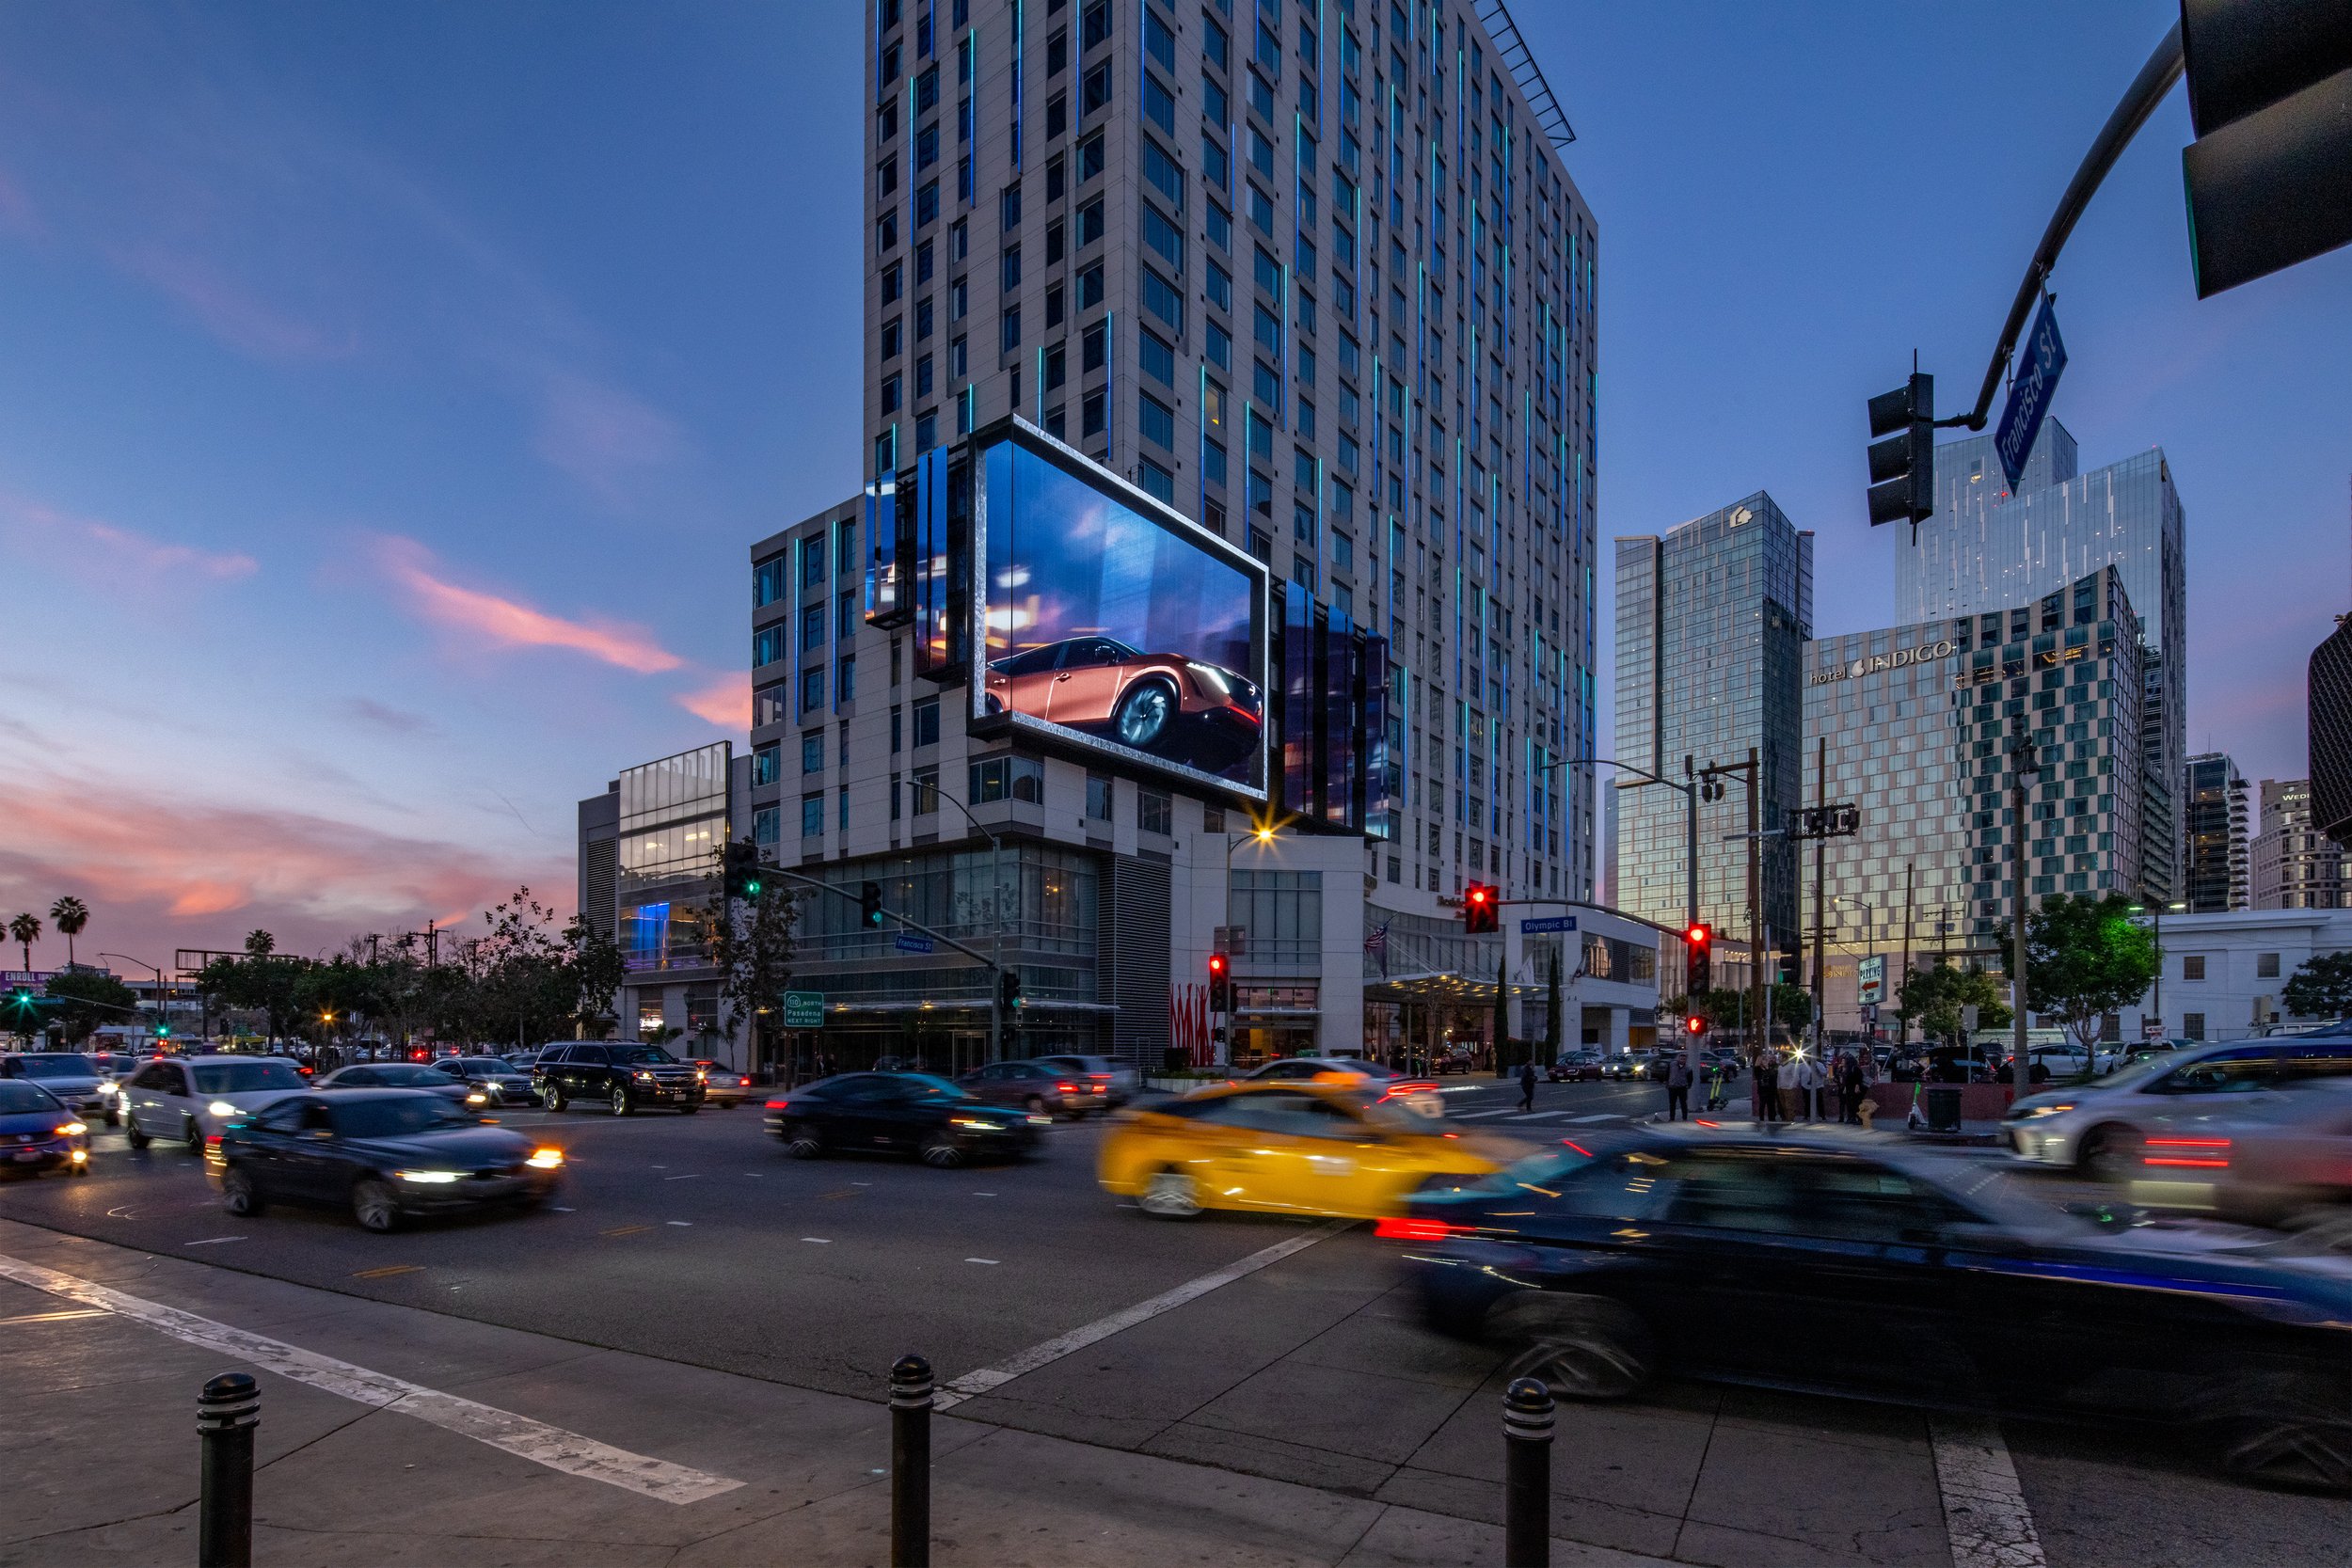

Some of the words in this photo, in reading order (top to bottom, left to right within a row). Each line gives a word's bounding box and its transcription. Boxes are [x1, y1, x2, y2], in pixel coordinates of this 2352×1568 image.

[2001, 363, 2043, 470] Francisco
[2039, 321, 2057, 370] St
[1810, 665, 1848, 685] hotel
[1869, 641, 1952, 673] INDIGO
[1525, 922, 1561, 931] Olympic
[1563, 919, 1573, 927] Bl
[898, 938, 924, 950] Francisco
[5, 972, 36, 981] ENROLL
[1859, 966, 1881, 980] PARKING
